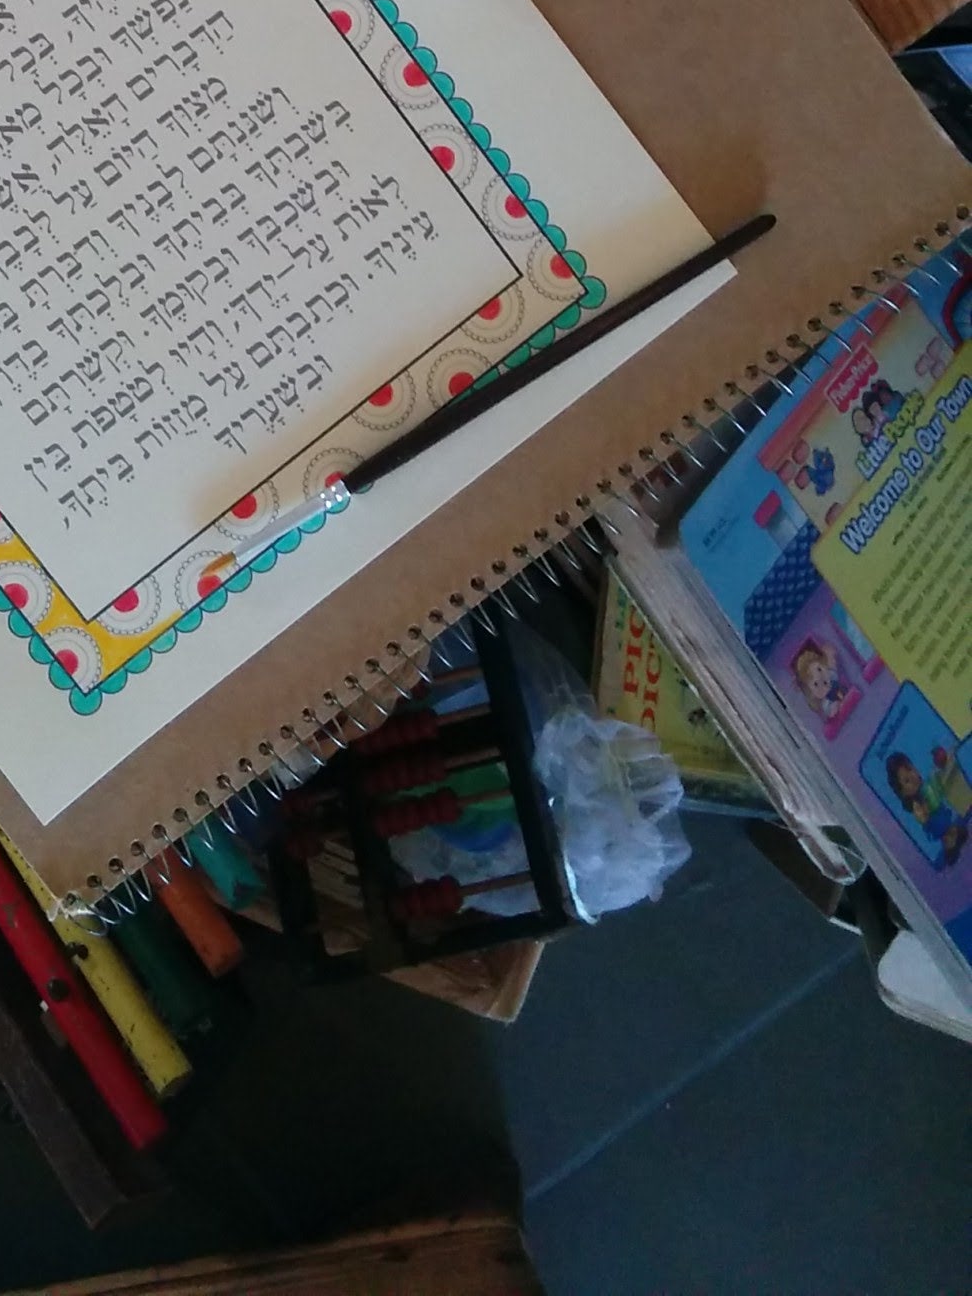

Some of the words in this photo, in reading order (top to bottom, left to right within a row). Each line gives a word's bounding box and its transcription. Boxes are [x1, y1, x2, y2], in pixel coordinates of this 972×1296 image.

[840, 468, 909, 553] Welcome
[900, 447, 923, 475] to
[915, 414, 945, 454] Our
[935, 375, 972, 422] Town
[856, 432, 897, 481] Little
[641, 633, 662, 732] DIC
